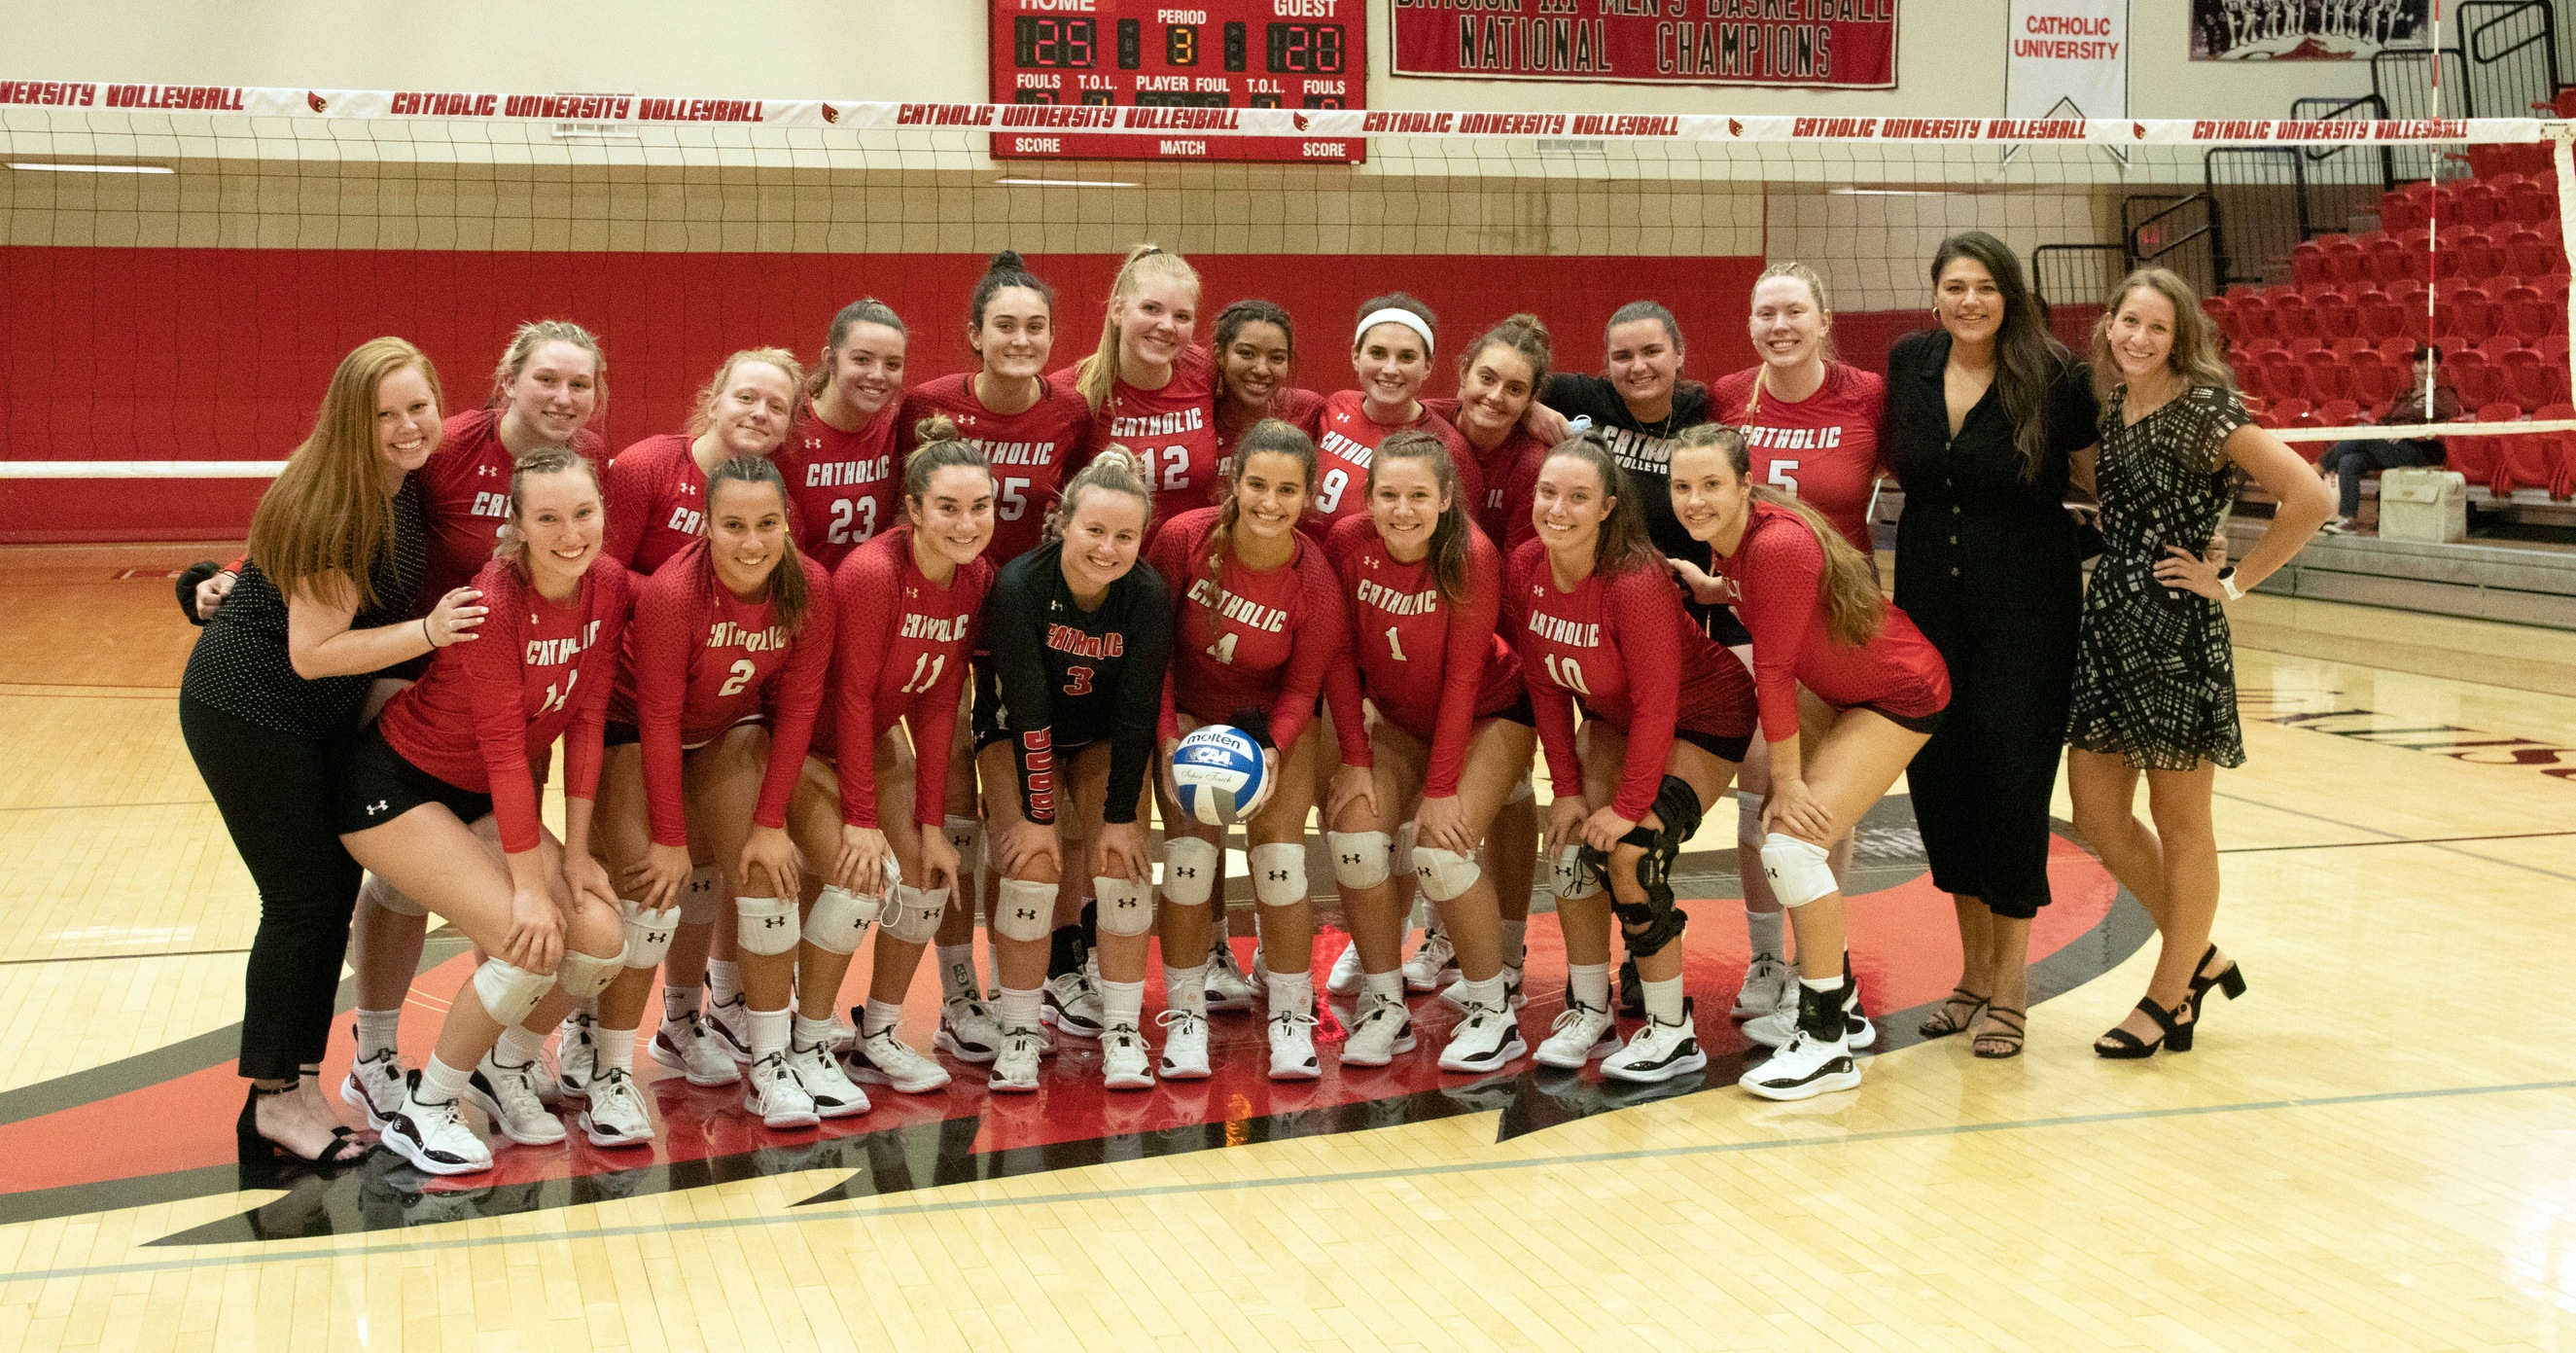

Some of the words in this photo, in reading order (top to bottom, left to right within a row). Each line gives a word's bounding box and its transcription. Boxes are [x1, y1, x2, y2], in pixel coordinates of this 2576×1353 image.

[1158, 10, 1207, 24] PERIOD
[1274, 0, 1337, 18] GUEST
[2027, 16, 2110, 36] CATHOLIC
[1035, 19, 1091, 66] 25
[1175, 28, 1192, 63] 3
[1286, 26, 1340, 71] 20
[1460, 16, 1612, 71] NATIONAL
[1656, 21, 1832, 77] CHAMPIONS
[2014, 40, 2120, 60] UNIVERSITY
[1016, 74, 1061, 89] FOULS
[1078, 75, 1118, 89] T.O.L.
[1137, 76, 1188, 91] PLAYER
[1196, 77, 1230, 92] FOUL
[1247, 79, 1286, 93] T.O.L.
[1303, 80, 1346, 94] FOULS
[106, 85, 244, 111] VOLLEYBALL
[391, 91, 498, 117] CATHOLIC
[504, 94, 630, 120] UNIVERSITY
[638, 98, 764, 123] VOLLEYBALL
[897, 103, 996, 126] CATHOLIC
[1001, 105, 1115, 128] UNIVERSITY
[1124, 107, 1239, 130] VOLLEYBALL
[1362, 111, 1454, 133] CATHOLIC
[1459, 113, 1567, 134] UNIVERSITY
[1572, 114, 1678, 136] VOLLEYBALL
[1792, 117, 1875, 138] CATHOLIC
[1882, 118, 1980, 139] UNIVERSITY
[1987, 119, 2087, 139] VOLLEYBALL
[2192, 120, 2272, 140] CATHOLIC
[2276, 120, 2368, 140] UNIVERSITY
[2375, 119, 2468, 140] VOLLEYBALL
[1015, 138, 1061, 153] SCORE
[1160, 140, 1206, 155] MATCH
[1303, 142, 1346, 157] SCORE
[1111, 407, 1203, 438] CATHOLIC
[1739, 424, 1842, 449] CATHOLIC
[961, 438, 1055, 466] THOLIC
[1320, 430, 1374, 470] CATHOL
[1603, 424, 1675, 463] CATHO
[805, 454, 890, 487] CATHOLIC
[1141, 445, 1190, 492] 12
[1614, 454, 1670, 475] VOLLEYB
[1768, 459, 1800, 498] 5
[991, 476, 1031, 521] 5
[1315, 468, 1350, 515] 9
[827, 495, 877, 545] 23
[1045, 623, 1123, 660] CATHOLIC
[1529, 609, 1600, 648] CATHOLIC
[1206, 631, 1239, 665] 4
[1386, 626, 1407, 661] 1
[718, 659, 756, 696] 2
[900, 652, 945, 694] 11
[1063, 665, 1095, 696] 3
[1544, 653, 1592, 694] 10
[1186, 732, 1241, 750] molten
[1181, 767, 1204, 781] Super
[1206, 771, 1233, 783] Touch
